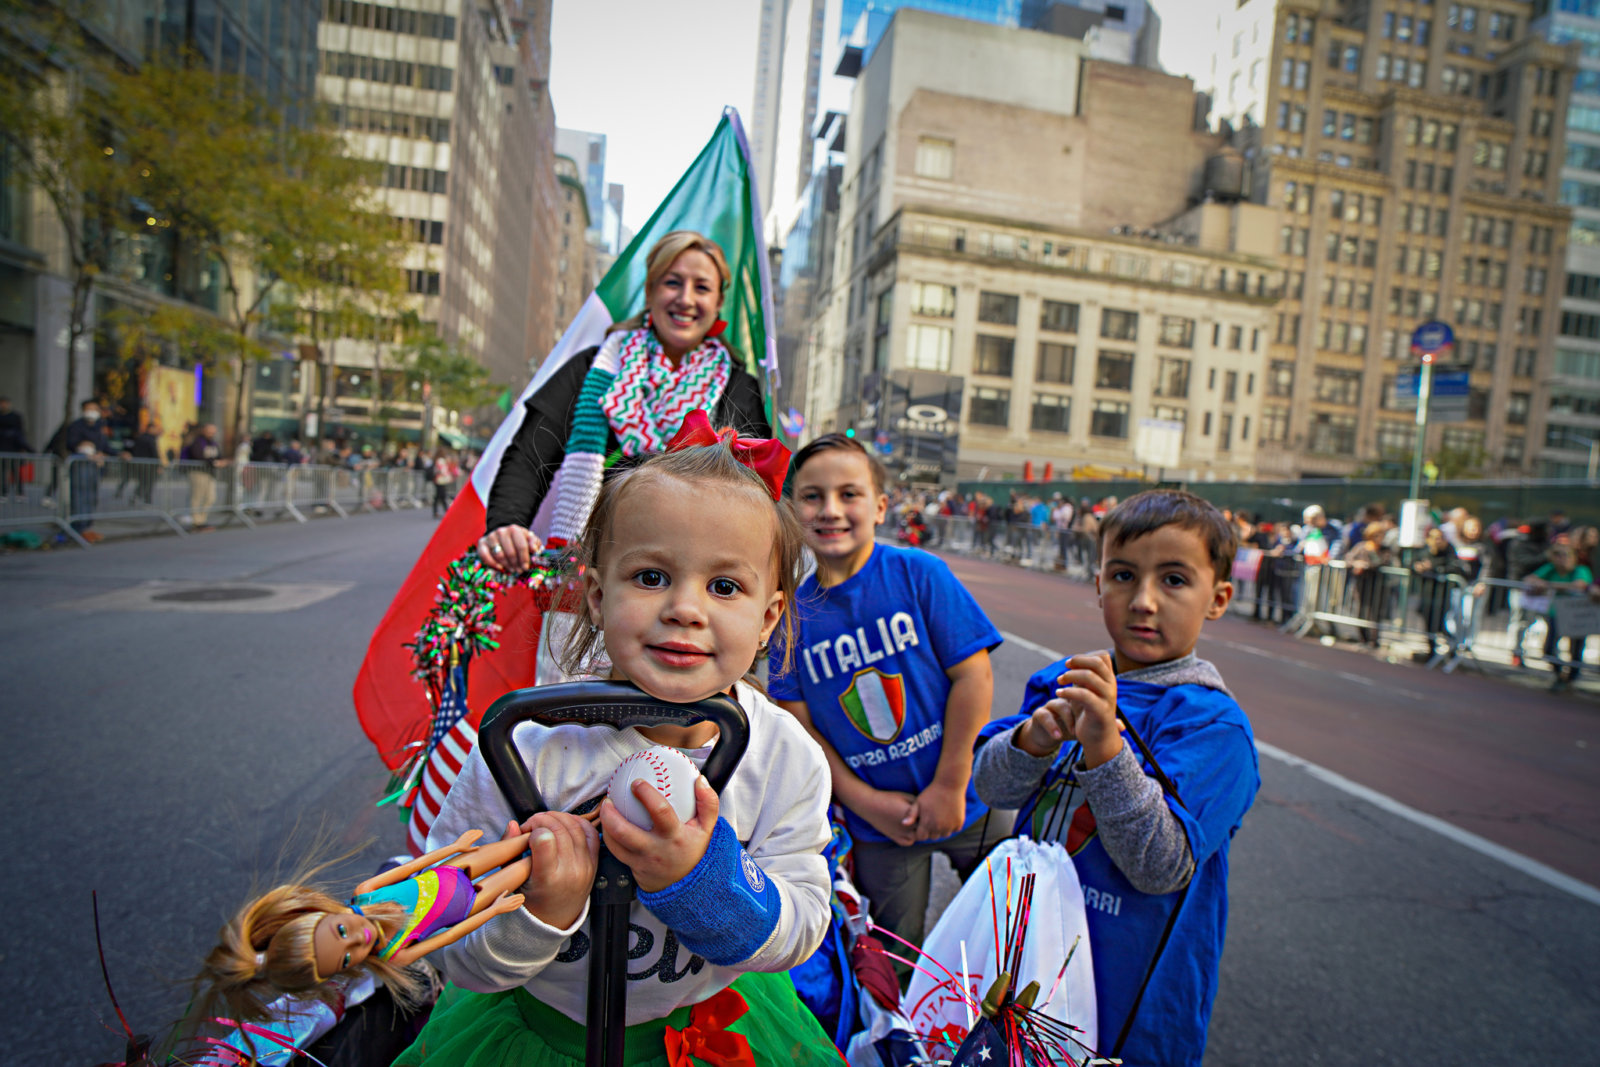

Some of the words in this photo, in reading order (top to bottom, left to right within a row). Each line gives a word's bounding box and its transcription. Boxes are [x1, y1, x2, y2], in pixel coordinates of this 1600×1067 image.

[803, 611, 919, 684] ITALIA
[845, 748, 888, 768] OZA
[1081, 884, 1122, 917] RRI
